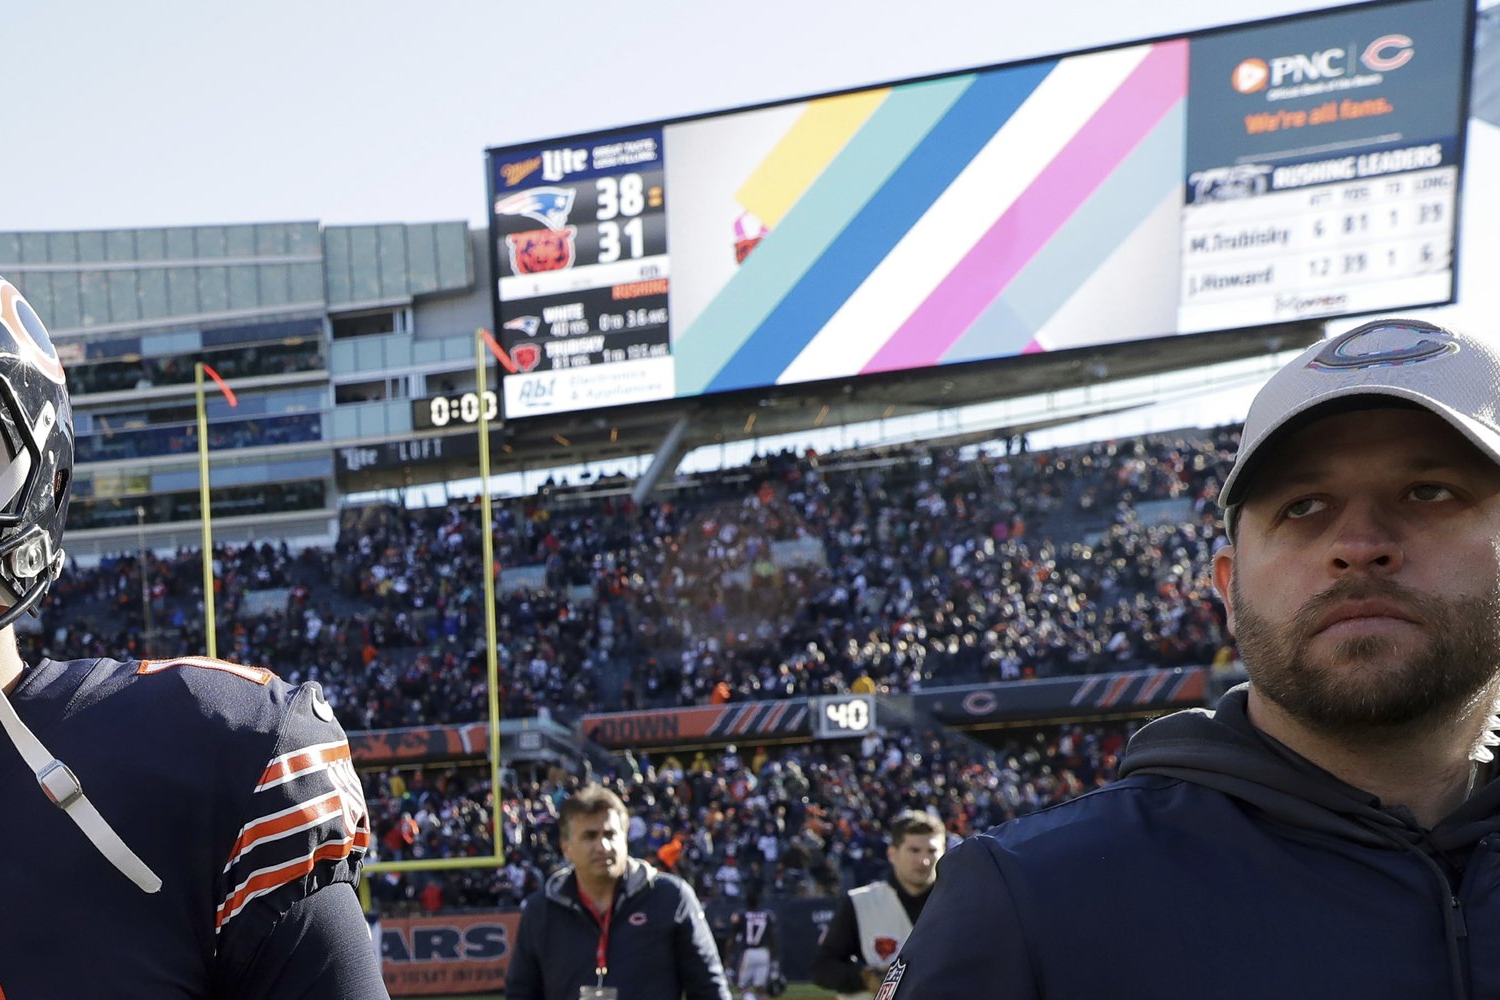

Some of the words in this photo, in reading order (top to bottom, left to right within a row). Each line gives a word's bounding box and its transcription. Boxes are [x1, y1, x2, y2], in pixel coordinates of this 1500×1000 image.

[1269, 47, 1345, 86] PNC
[1244, 109, 1306, 135] We're
[1308, 101, 1338, 125] all
[1340, 97, 1395, 119] fans.
[542, 148, 589, 182] Lite
[1271, 156, 1357, 190] RUSHING
[1357, 143, 1442, 177] LEADERS
[596, 173, 645, 220] 38
[598, 217, 644, 264] 31
[612, 279, 668, 300] RUSHING
[519, 377, 557, 401] Abt
[430, 390, 498, 426] 0:00
[399, 437, 442, 461] LOFT
[603, 714, 680, 742] DOWN
[826, 699, 868, 731] 40
[382, 922, 509, 964] ARS
[745, 921, 767, 946] 17
